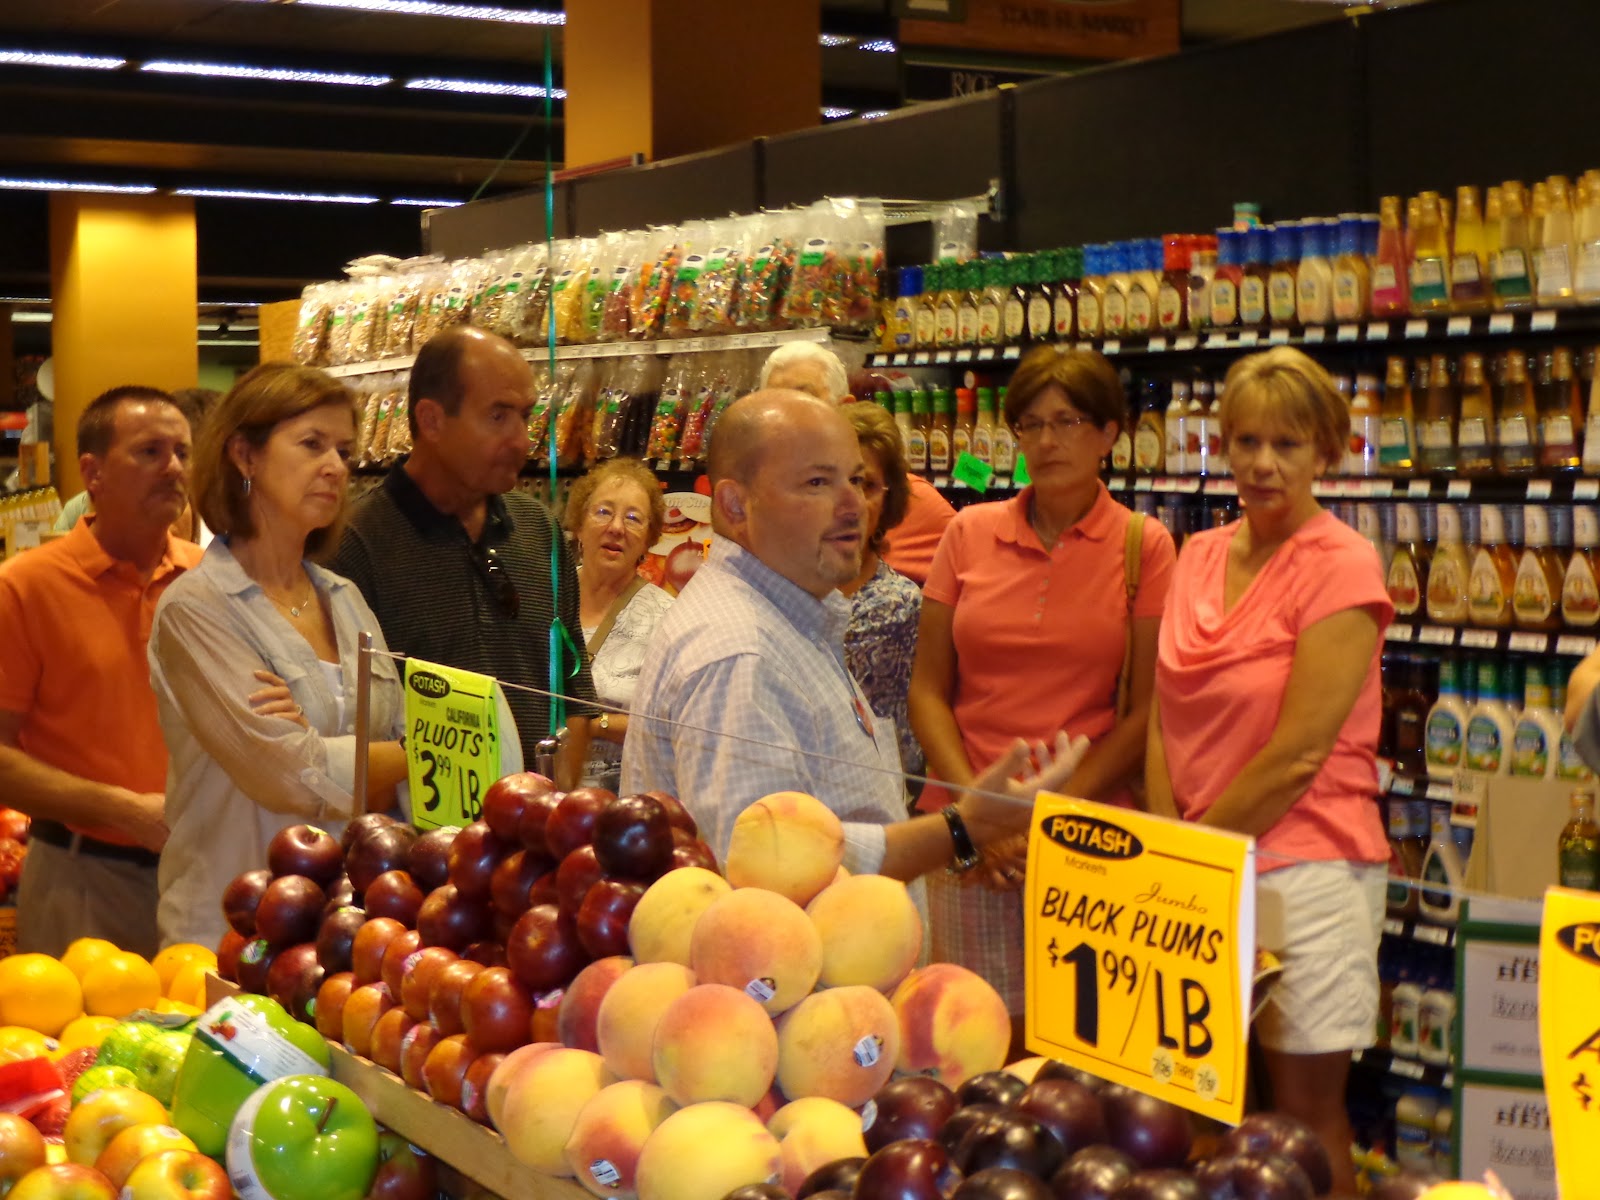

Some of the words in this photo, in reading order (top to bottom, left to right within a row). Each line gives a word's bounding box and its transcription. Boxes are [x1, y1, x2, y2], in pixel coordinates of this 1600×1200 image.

[413, 674, 446, 694] POTASH
[413, 718, 483, 757] PLUOTS
[1050, 817, 1131, 856] POTASH
[1134, 882, 1208, 914] Jumbo
[1040, 886, 1124, 937] BLACK
[1129, 910, 1223, 965] PLUMS
